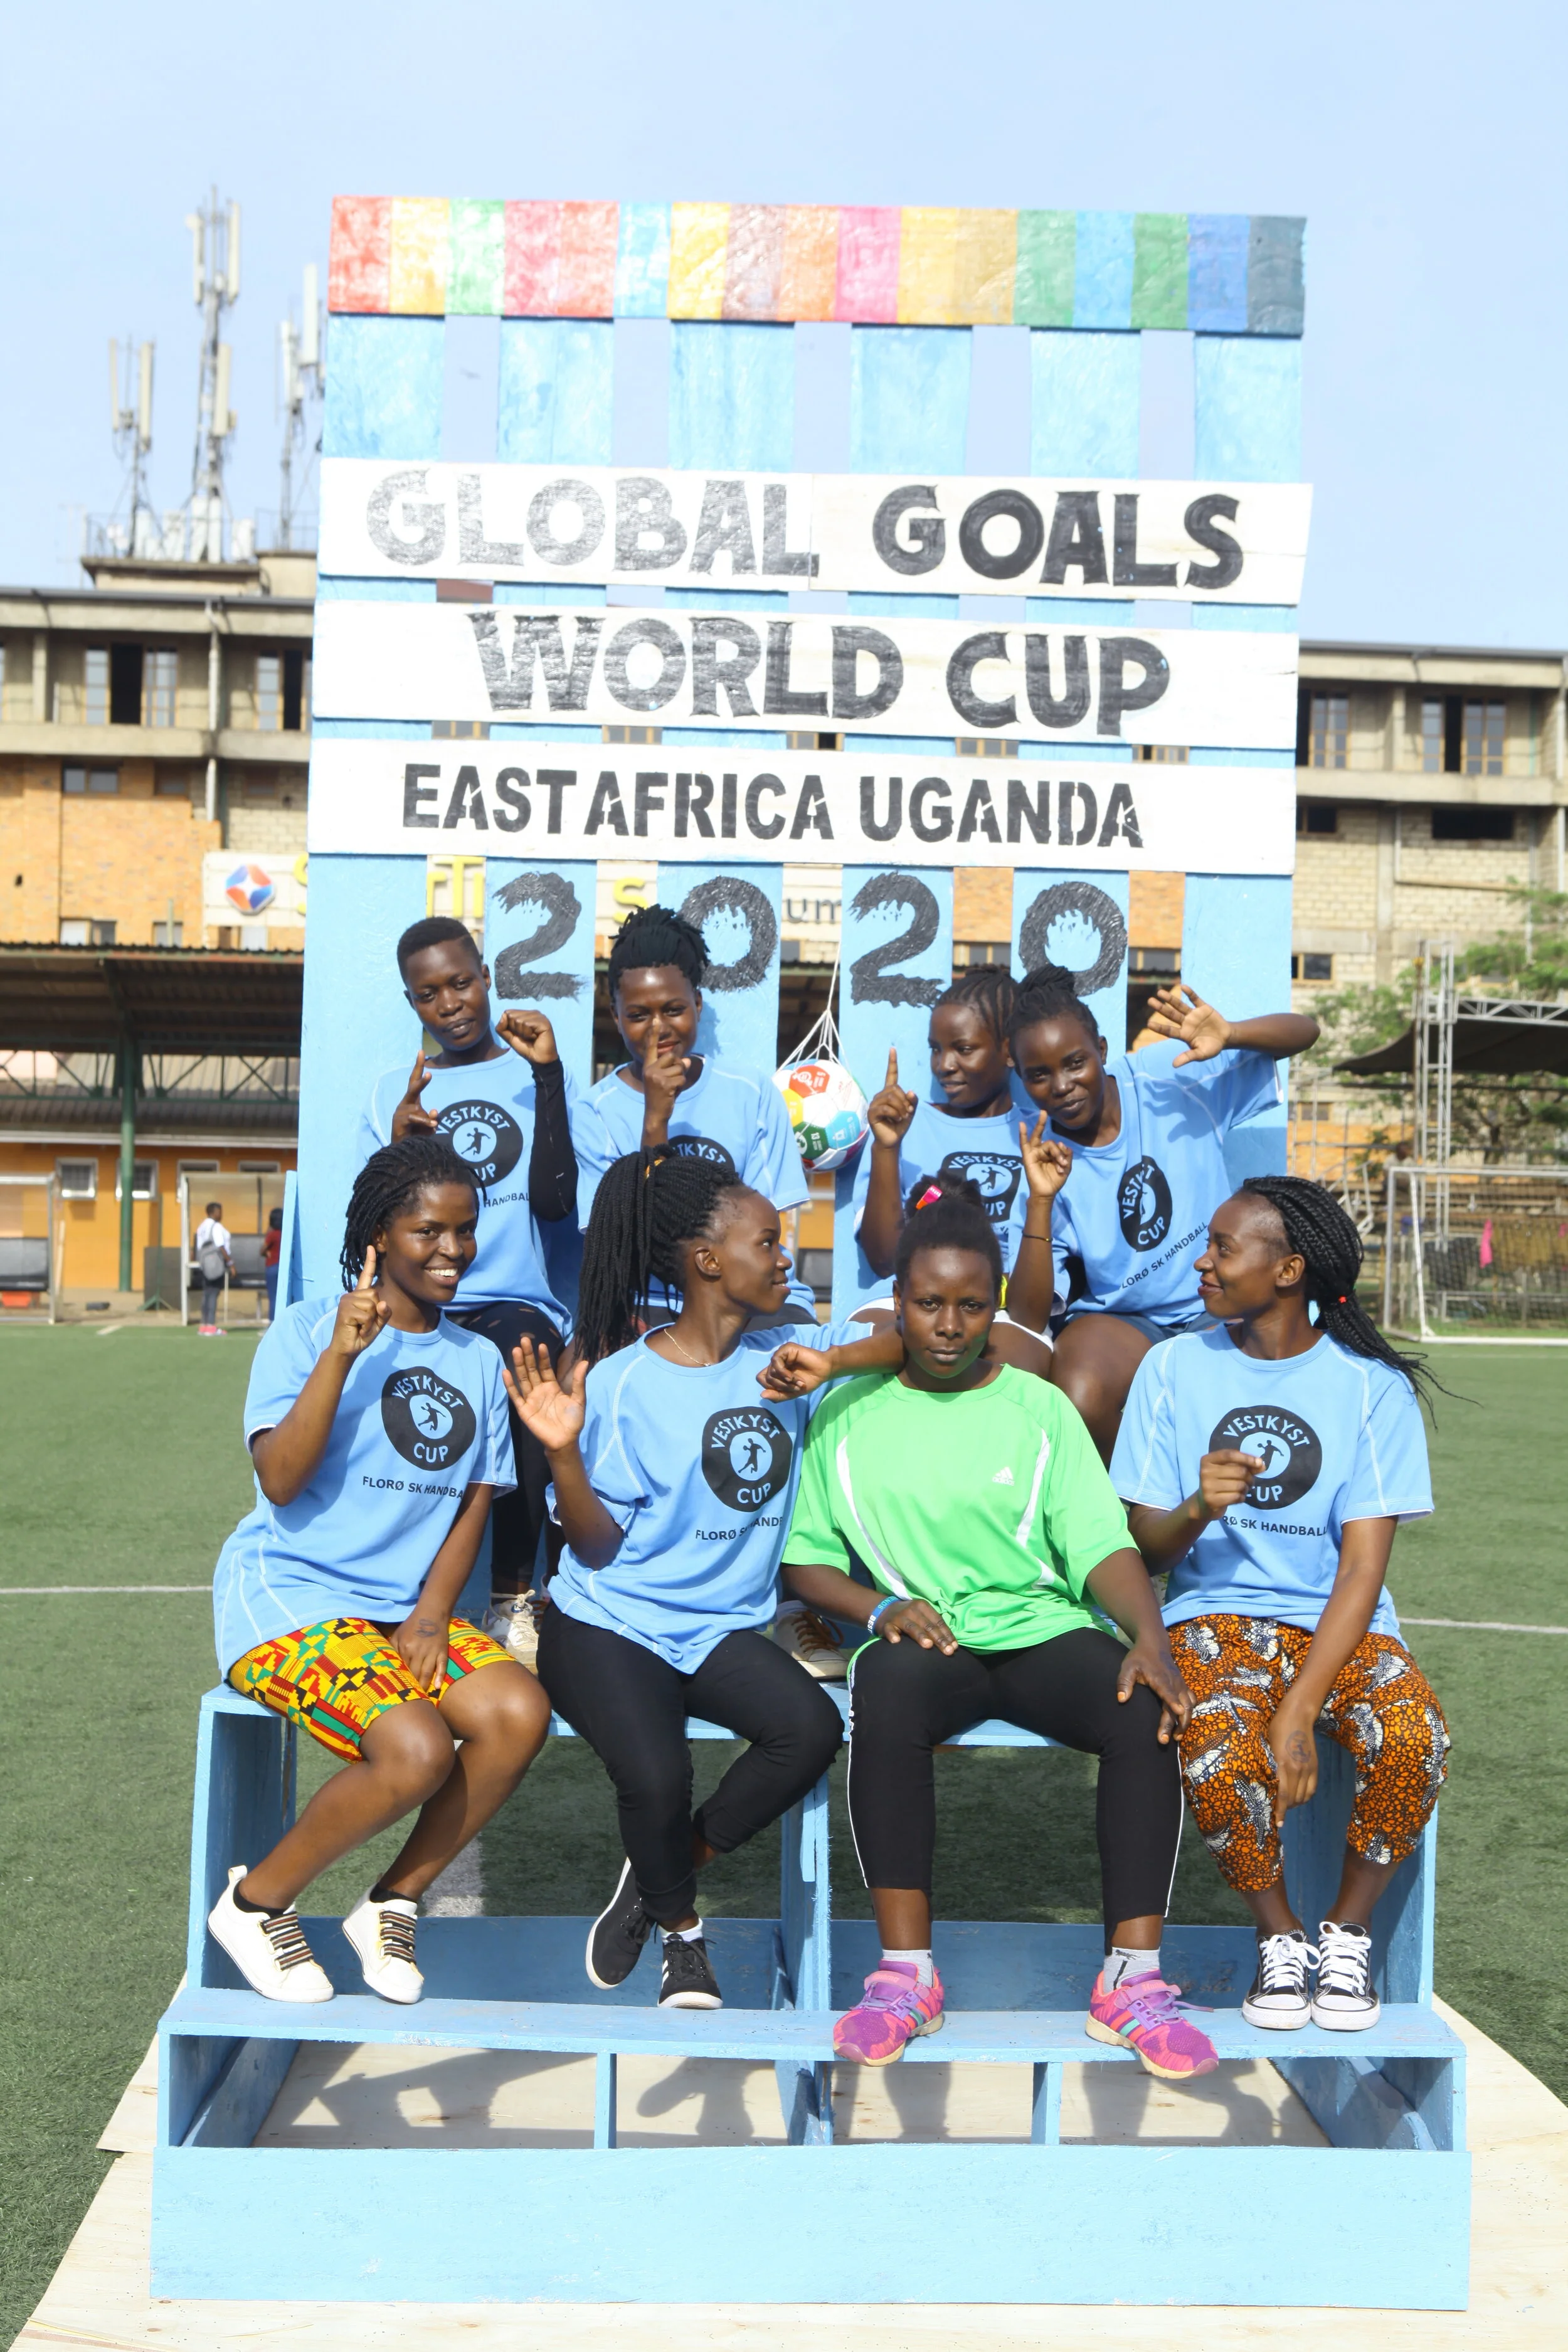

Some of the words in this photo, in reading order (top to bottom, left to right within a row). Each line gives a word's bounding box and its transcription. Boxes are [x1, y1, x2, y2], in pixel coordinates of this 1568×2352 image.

[366, 468, 820, 578] GLOBAL
[872, 484, 1244, 590] GOALS
[465, 610, 904, 720] WORLD
[946, 632, 1170, 736] CUP
[403, 763, 577, 834] EAST
[584, 771, 835, 840] AFRICA
[859, 776, 1144, 849] UGANDA
[435, 1106, 510, 1135] VESTKYST
[672, 1143, 726, 1163] TKYST
[949, 1155, 1024, 1171] VESTKYST
[475, 1163, 496, 1181] UP
[484, 1192, 530, 1208] HANDBAL
[985, 1201, 1005, 1216] UP
[1138, 1216, 1165, 1245] CUP
[1122, 1268, 1148, 1289] LORØ
[1151, 1258, 1165, 1271] SK
[1165, 1222, 1208, 1261] HANDBALL
[391, 1375, 464, 1408] VESTKYST
[711, 1414, 780, 1449] VESTKYST
[1222, 1414, 1310, 1447] VESTKYST
[413, 1443, 448, 1463] CUP
[363, 1476, 404, 1490] FLORØ
[408, 1483, 423, 1493] SK
[424, 1485, 464, 1500] HANDBA
[737, 1482, 771, 1504] CUP
[696, 1529, 736, 1540] FLORØ
[1241, 1518, 1257, 1530] SK
[1261, 1521, 1328, 1537] HANDBALL
